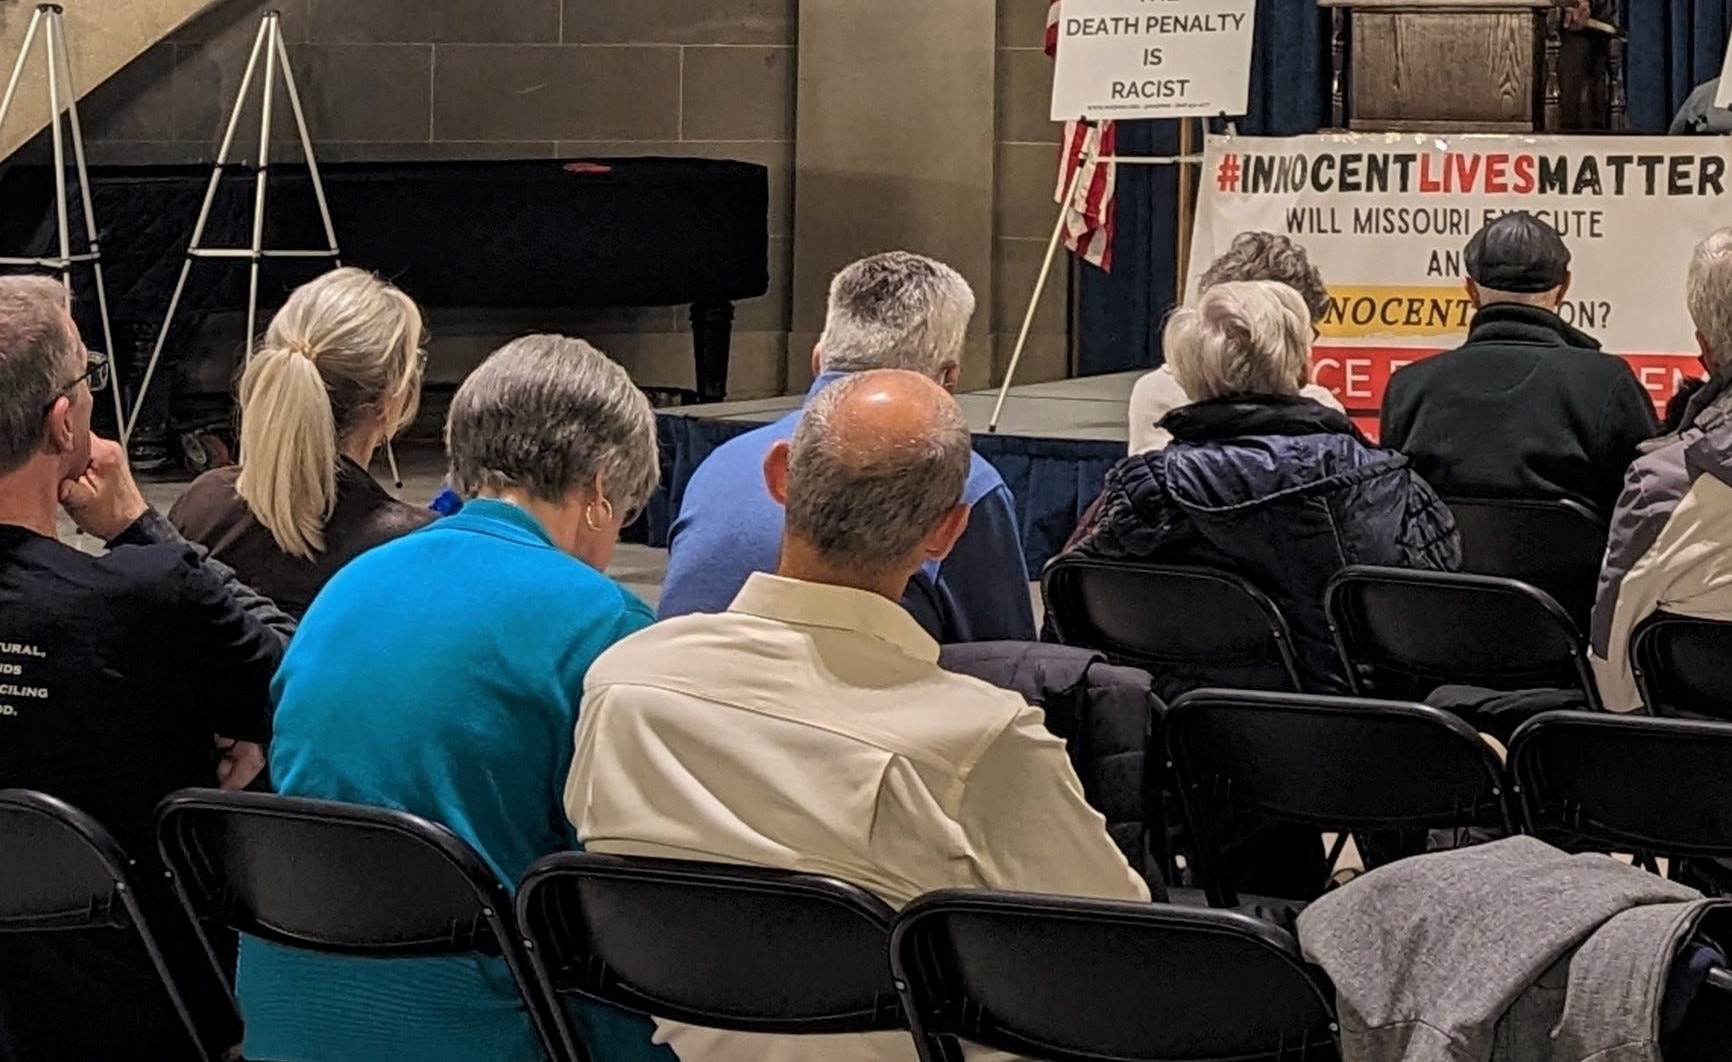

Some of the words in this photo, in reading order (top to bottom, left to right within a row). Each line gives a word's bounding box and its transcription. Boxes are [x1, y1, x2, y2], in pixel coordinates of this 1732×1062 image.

[1066, 16, 1139, 36] DEATH
[1146, 13, 1246, 34] PENALTY
[1143, 48, 1163, 66] IS
[1111, 79, 1190, 99] RACIST
[1286, 207, 1342, 234] WILL
[1353, 208, 1470, 235] MISSOURI
[1427, 249, 1460, 276] AN
[1324, 297, 1471, 327] NOCENT
[1557, 301, 1611, 329] ON?
